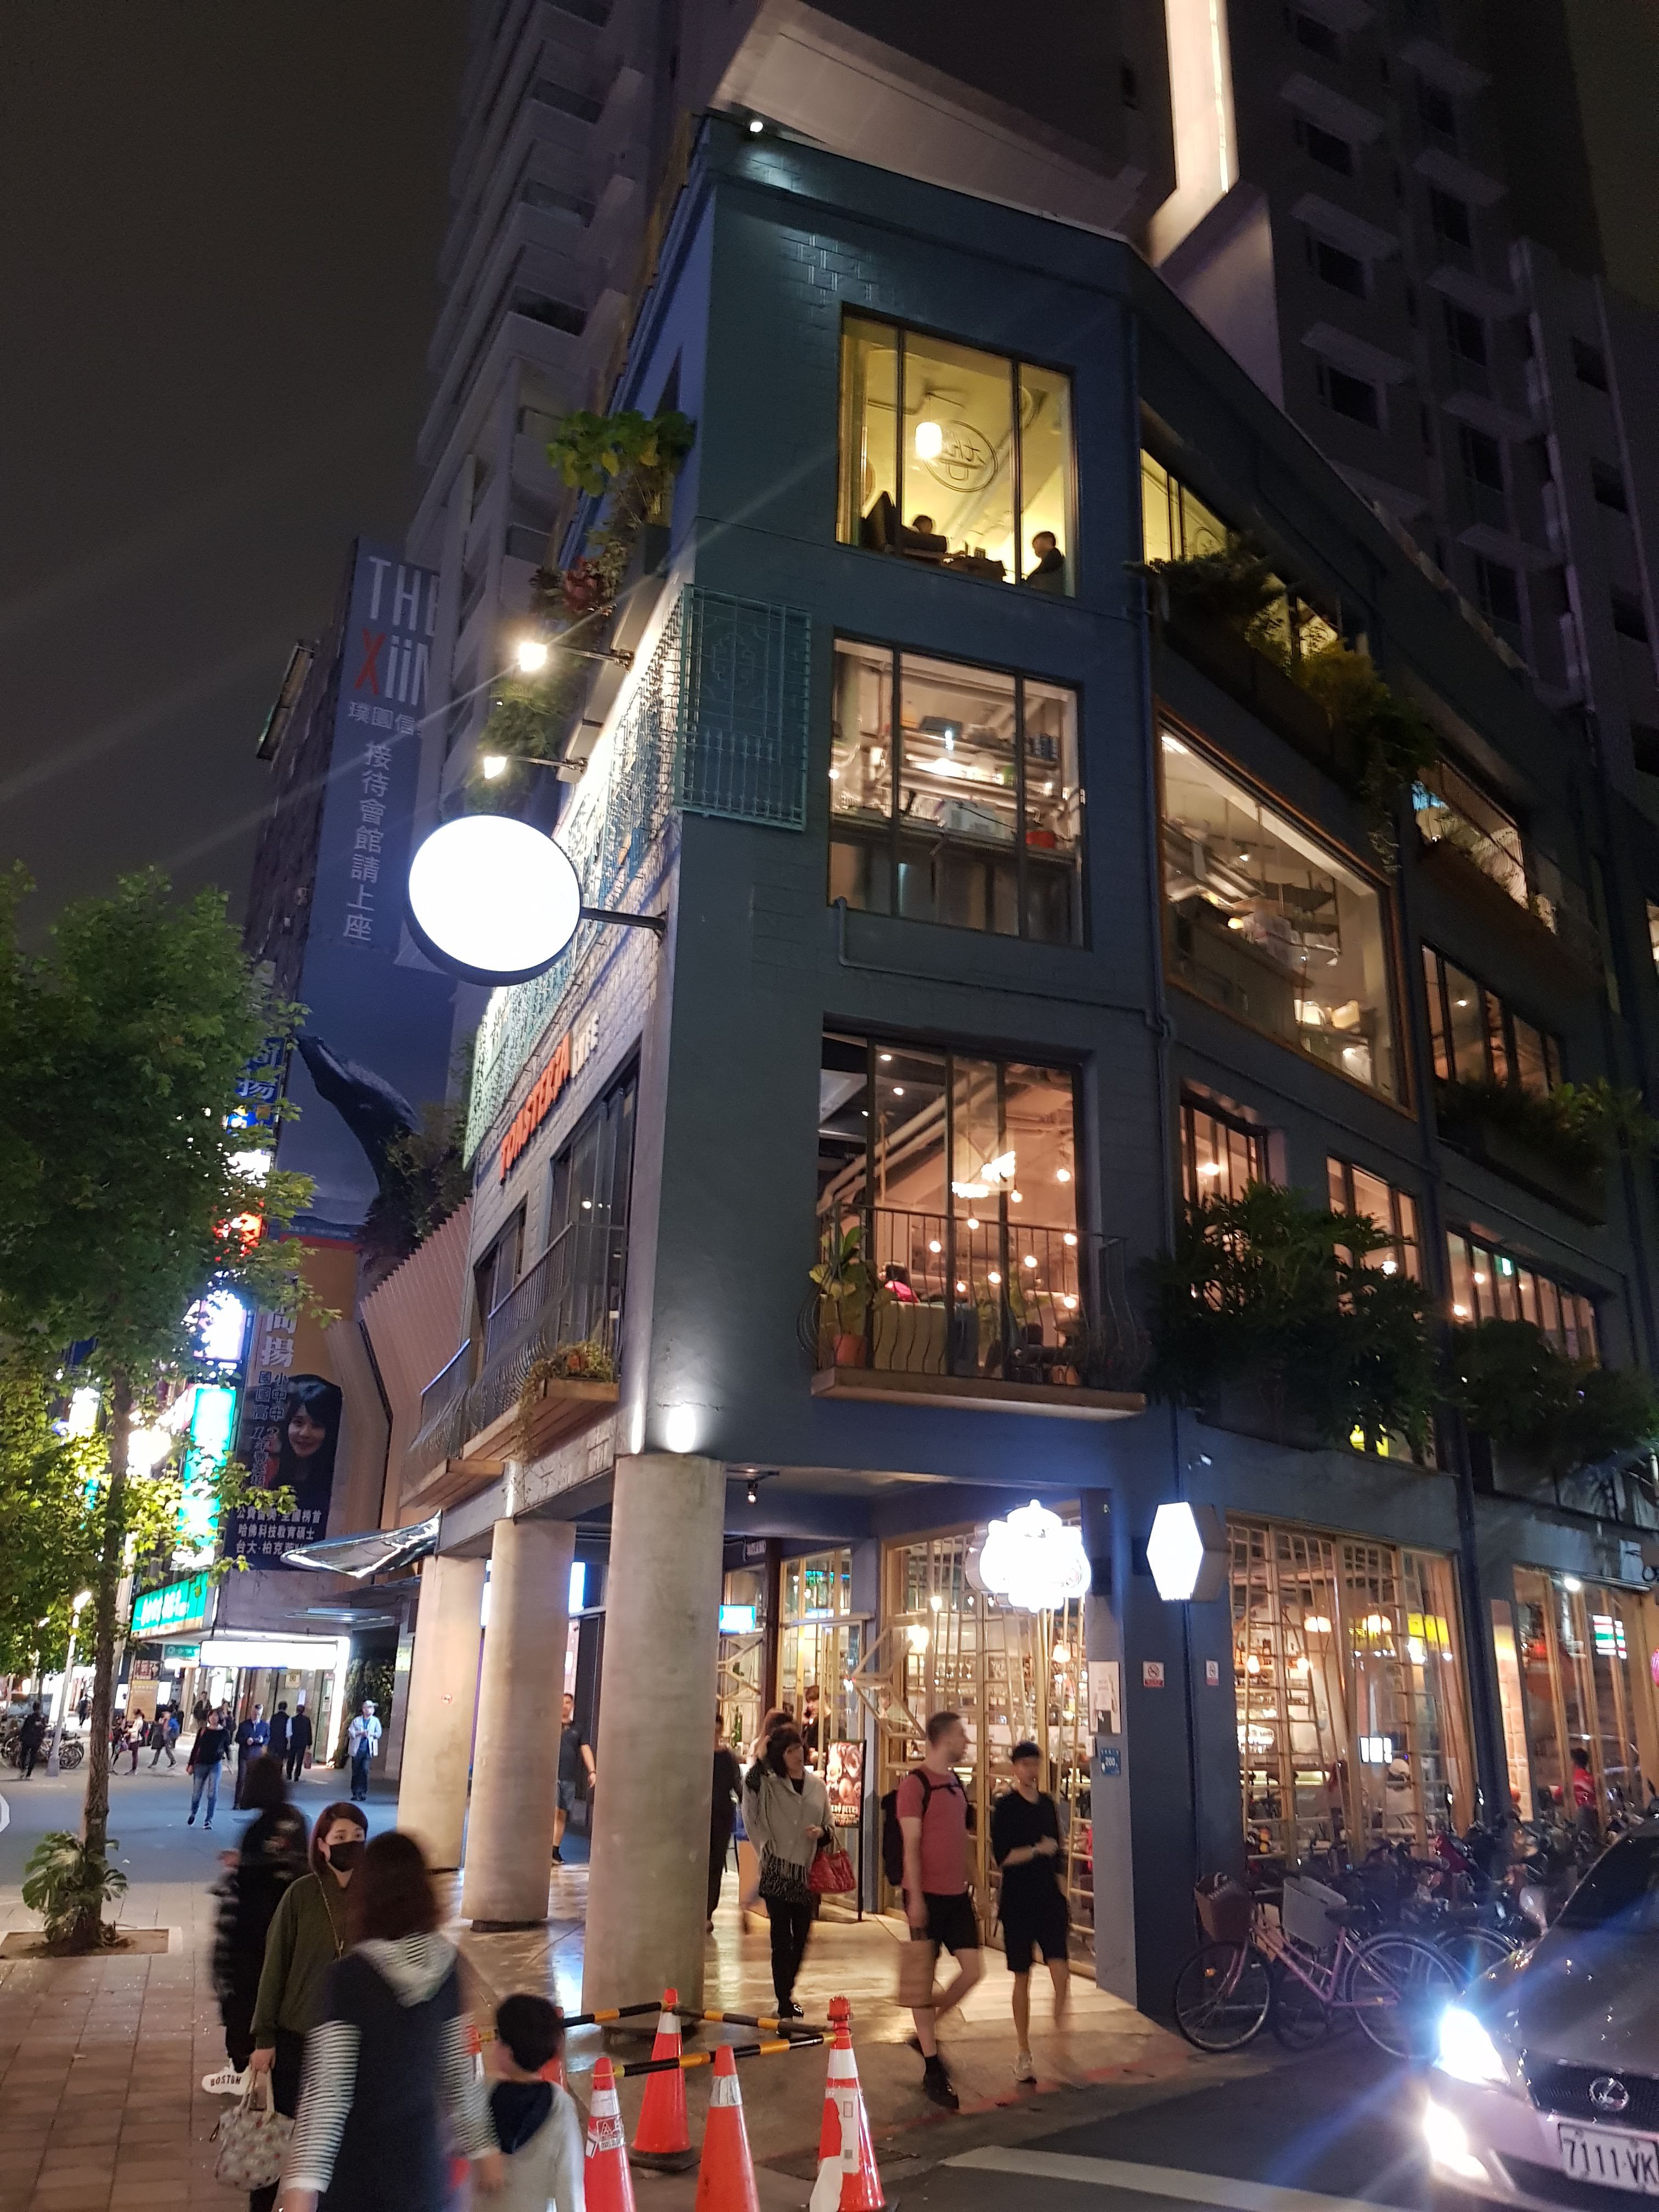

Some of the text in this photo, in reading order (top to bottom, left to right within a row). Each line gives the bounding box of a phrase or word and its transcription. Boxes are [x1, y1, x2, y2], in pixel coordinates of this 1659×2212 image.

[342, 741, 392, 941] 接待會館請上座
